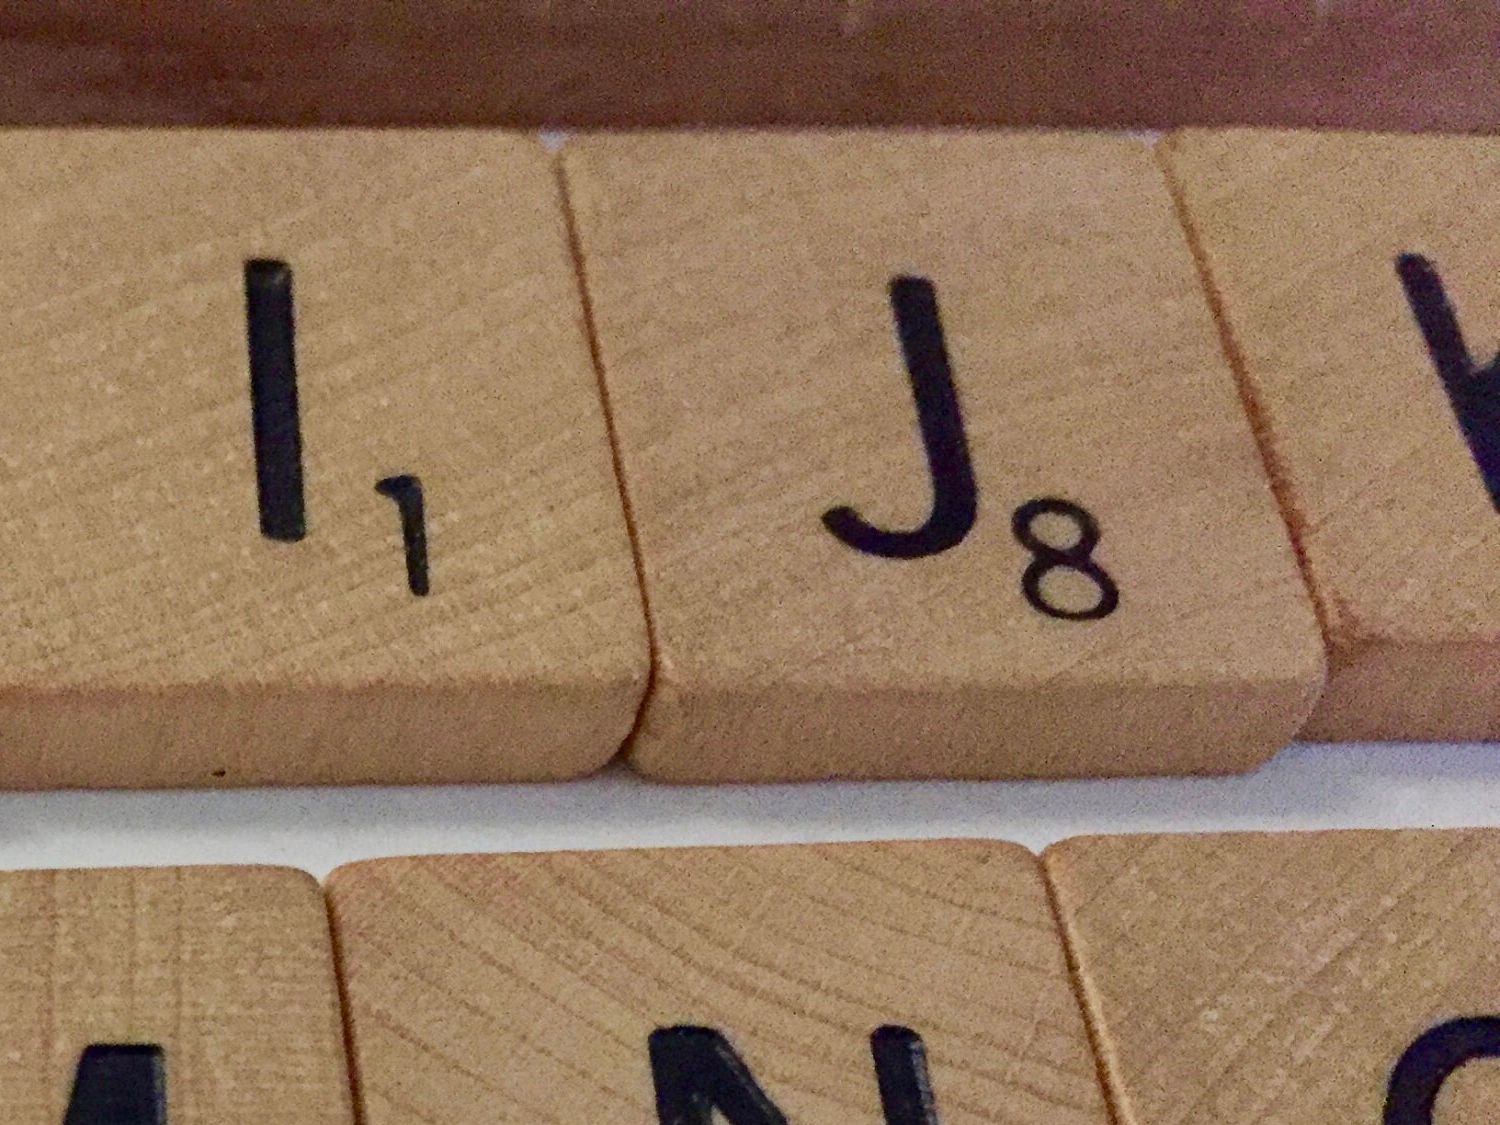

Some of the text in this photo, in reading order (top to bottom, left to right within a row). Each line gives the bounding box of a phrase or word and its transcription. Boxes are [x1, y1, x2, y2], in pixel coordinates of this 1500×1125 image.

[245, 259, 429, 595] I 1
[822, 276, 1119, 621] J 8
